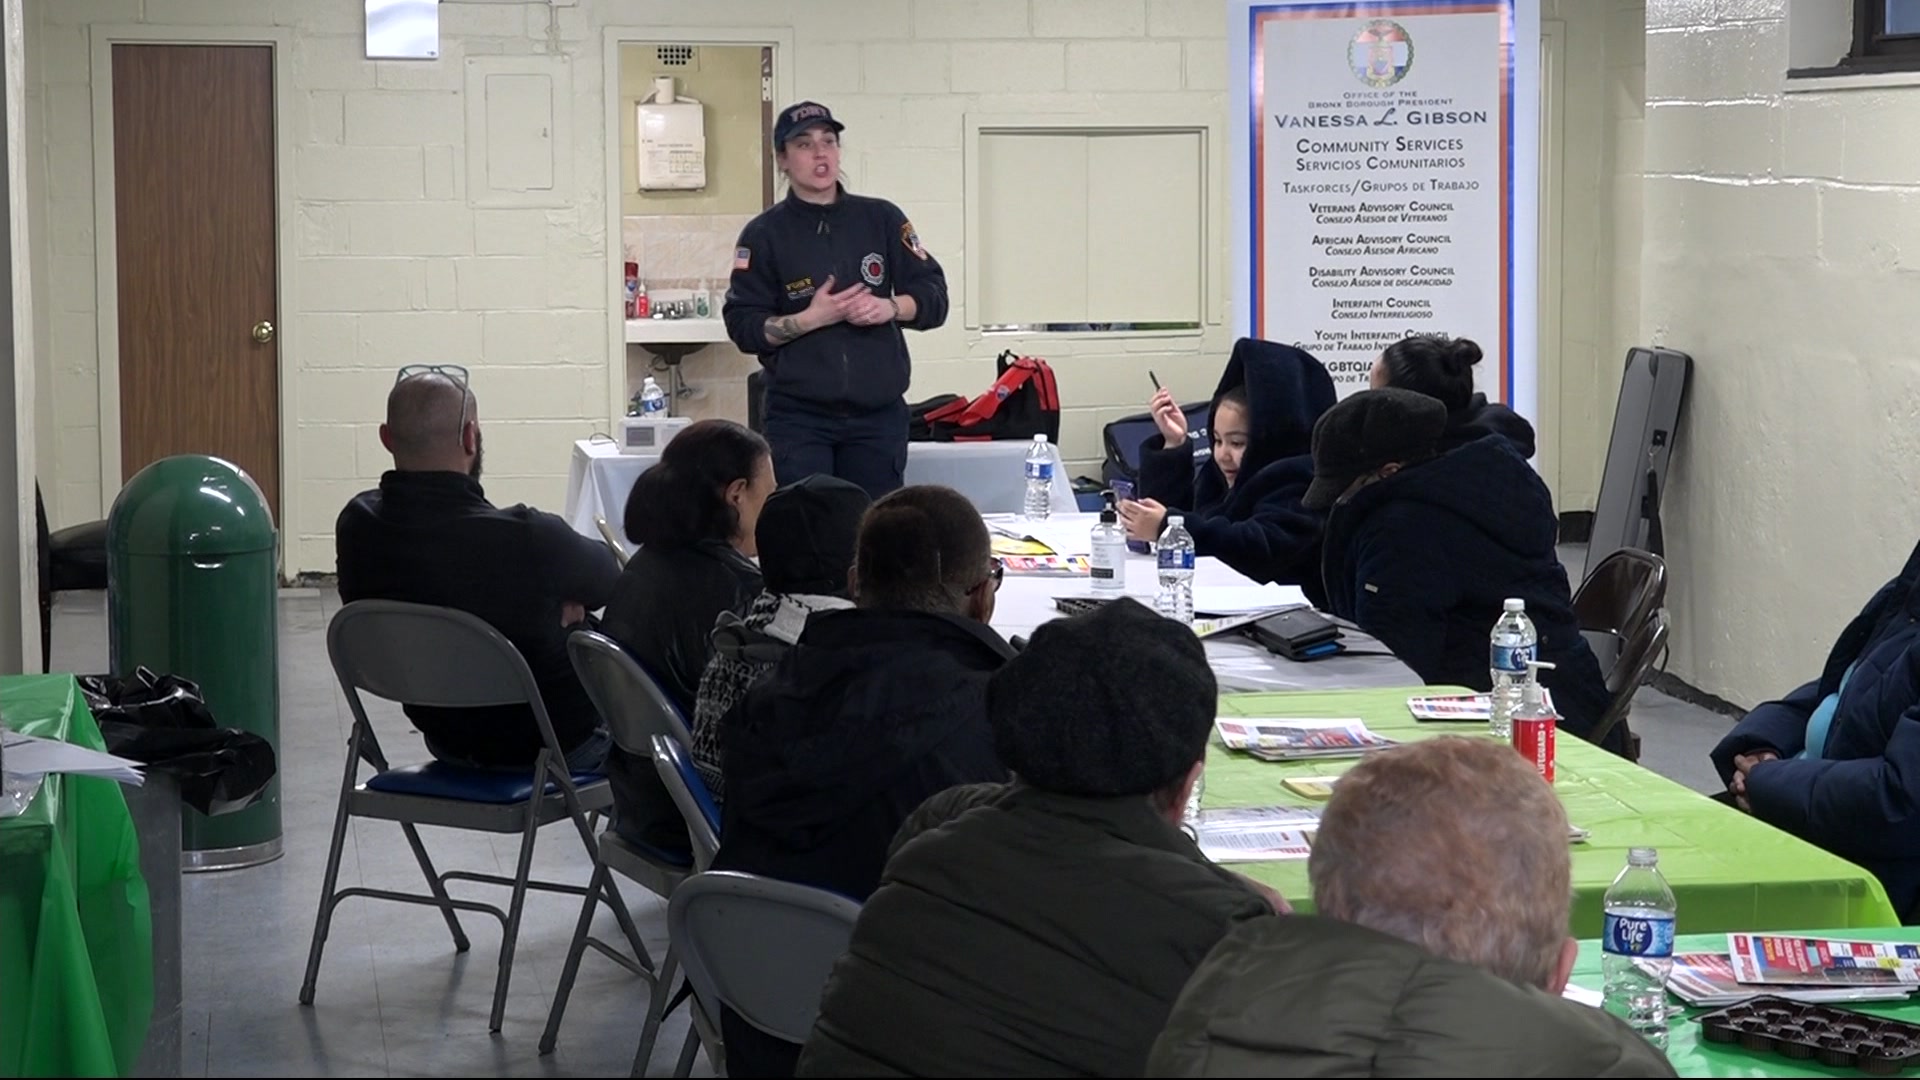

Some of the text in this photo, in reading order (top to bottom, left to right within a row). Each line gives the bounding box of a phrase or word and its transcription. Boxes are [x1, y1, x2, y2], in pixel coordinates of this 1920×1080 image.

[1275, 115, 1368, 128] VANESSA
[1407, 111, 1487, 125] GIBSON
[1296, 136, 1463, 154] COMMUNITY SERVICES
[1296, 156, 1465, 171] SERVICIOS COMUNITARIOS
[1413, 182, 1425, 191] DE
[1429, 179, 1479, 191] TRABAJO
[1309, 201, 1454, 213] VETERANS ADVISORY COUNCIL
[1316, 215, 1353, 224] CONSEJO
[1354, 214, 1386, 223] ASESOR
[1401, 213, 1448, 222] VETERANOS
[1312, 233, 1452, 245] AFRICAN ADVISORY COUNCIL
[1325, 246, 1362, 256] CONSEJO
[1363, 246, 1395, 255] ASESOR
[1309, 265, 1455, 277] DISABILITY ADVISORY COUNCIL
[1312, 278, 1348, 288] CONSEJO
[1350, 278, 1381, 287] ASESOR
[1332, 297, 1431, 308] INTERFAITH COUNCIL
[1331, 309, 1433, 319] CONSEJO INTERRELIGIOSO
[1315, 330, 1347, 340] YOUTH
[1351, 330, 1401, 340] INTERFAITH
[1337, 341, 1372, 350] TRABAJO
[1620, 917, 1647, 931] Pure
[1622, 928, 1645, 944] Life
